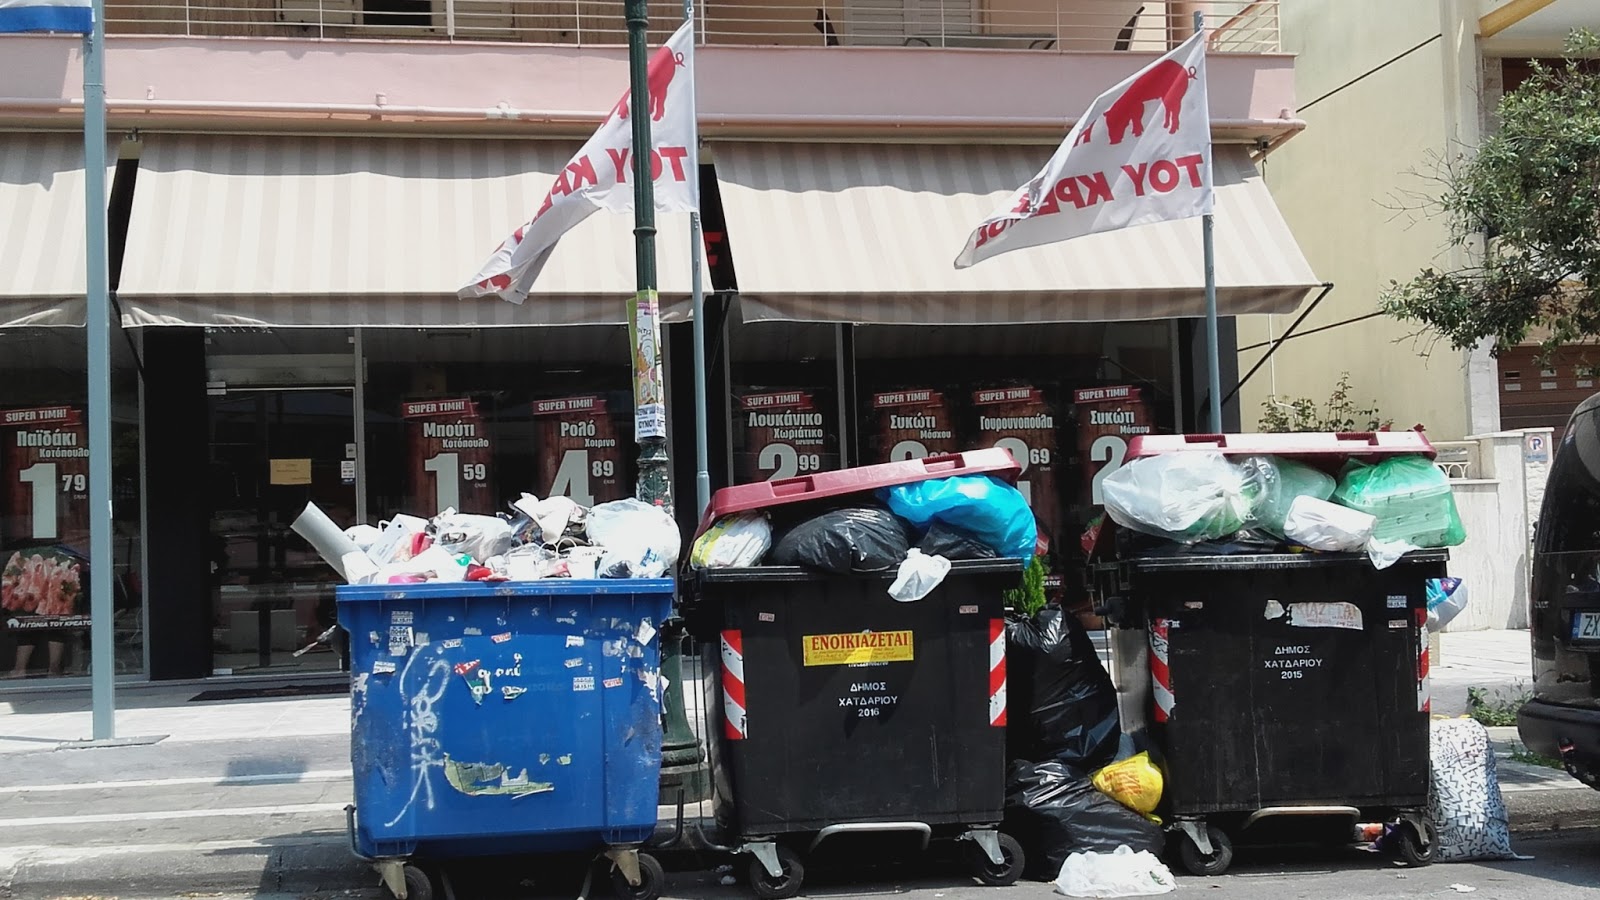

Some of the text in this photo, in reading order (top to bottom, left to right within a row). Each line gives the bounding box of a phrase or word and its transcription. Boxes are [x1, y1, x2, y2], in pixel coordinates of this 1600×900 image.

[747, 396, 774, 406] SUPER
[878, 395, 904, 404] SUPER
[979, 392, 1005, 402] SUPER
[1079, 391, 1104, 400] SUPER
[408, 403, 437, 414] SUPER
[538, 401, 566, 412] SUPER
[6, 411, 36, 422] SUPER
[748, 409, 822, 427] Λουκάνικο
[890, 413, 936, 430] Συκώτι
[1090, 408, 1135, 425] Συκώτι
[423, 419, 475, 438] Μπούτι
[560, 420, 596, 437] Ρολό
[774, 427, 823, 440] Χωριάτικο
[16, 428, 77, 447] Παϊδάκι
[442, 438, 489, 448] Κοτόπουλο
[39, 448, 90, 458] Κοτόπουλο
[1030, 448, 1050, 464] 69
[798, 454, 820, 471] 99
[424, 452, 486, 514] 1 59
[549, 450, 614, 507] 4 89
[20, 462, 86, 539] 1 79
[812, 633, 908, 650] ΕΝΟΙΚΙΑΖΕΤΑΙ
[1274, 646, 1310, 654] ΔΗΜΟΣ
[1281, 670, 1302, 679] 2015
[850, 682, 886, 692] ΔΗΜΟΣ
[858, 708, 880, 716] 2016
